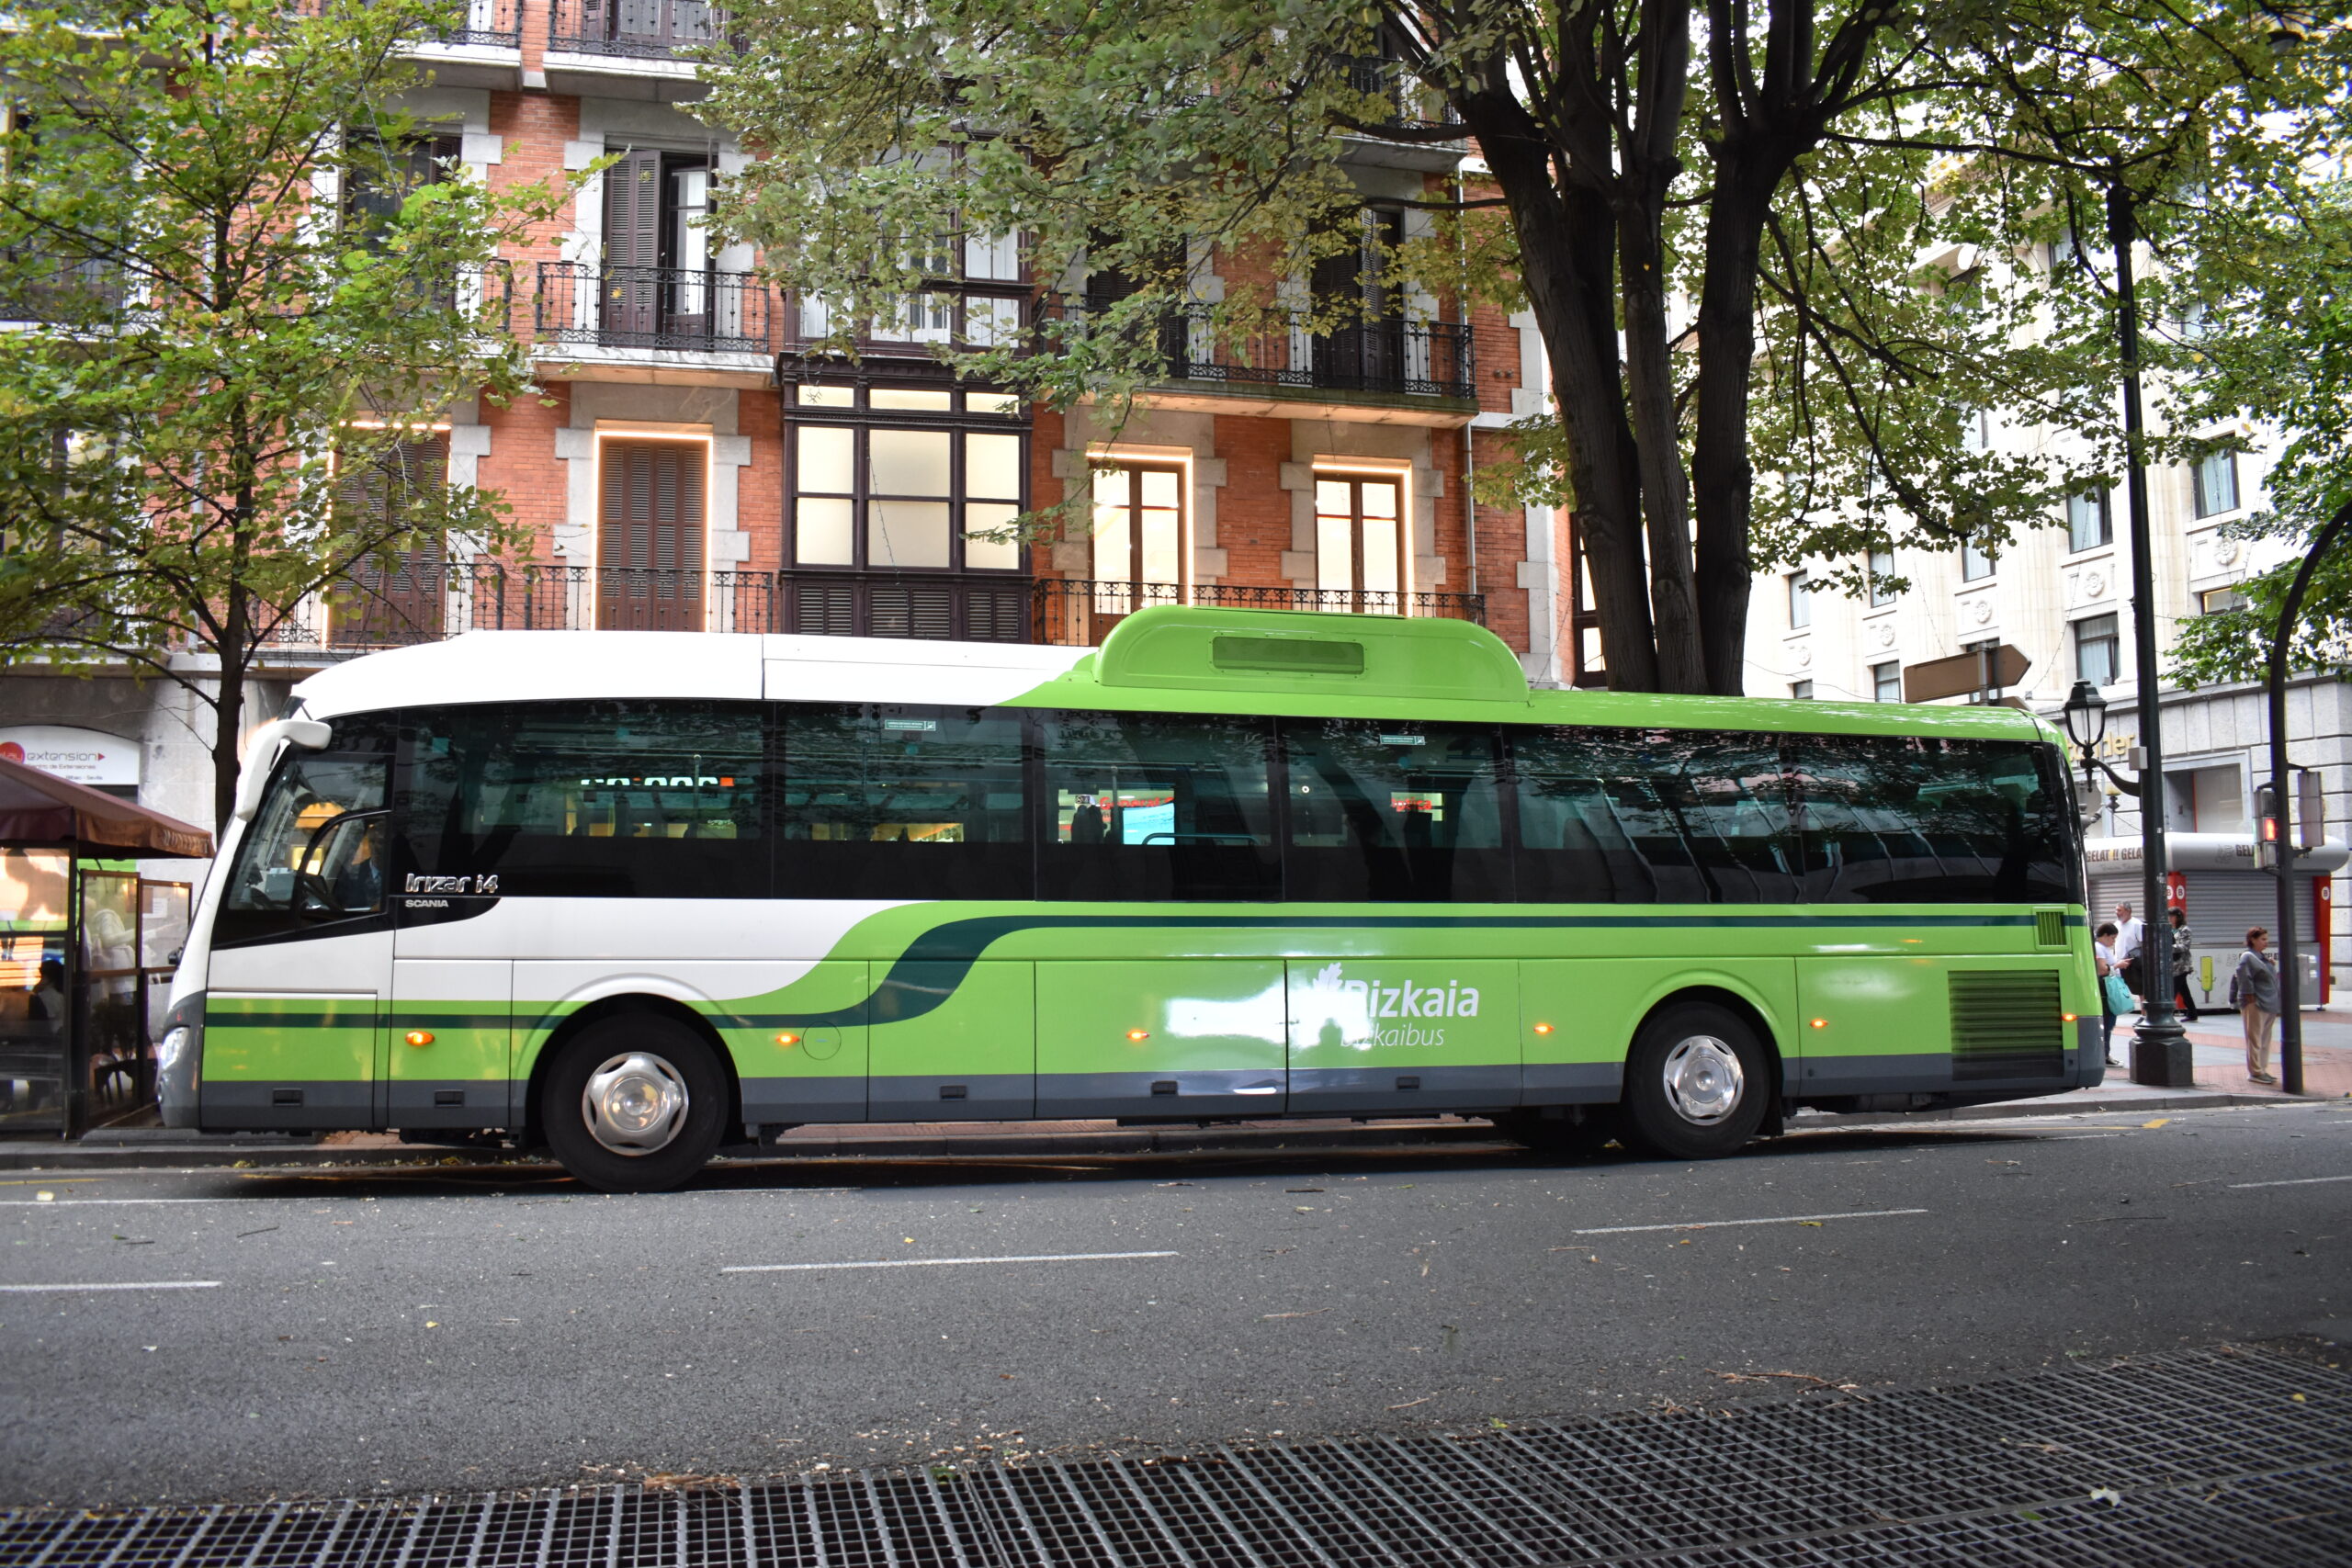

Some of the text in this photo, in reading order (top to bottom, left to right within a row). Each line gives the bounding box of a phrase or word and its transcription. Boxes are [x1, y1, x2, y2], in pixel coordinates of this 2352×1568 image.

[27, 750, 96, 761] extension
[2120, 847, 2143, 861] GELA
[405, 873, 499, 894] Irizar i4
[405, 899, 448, 908] SCANIA
